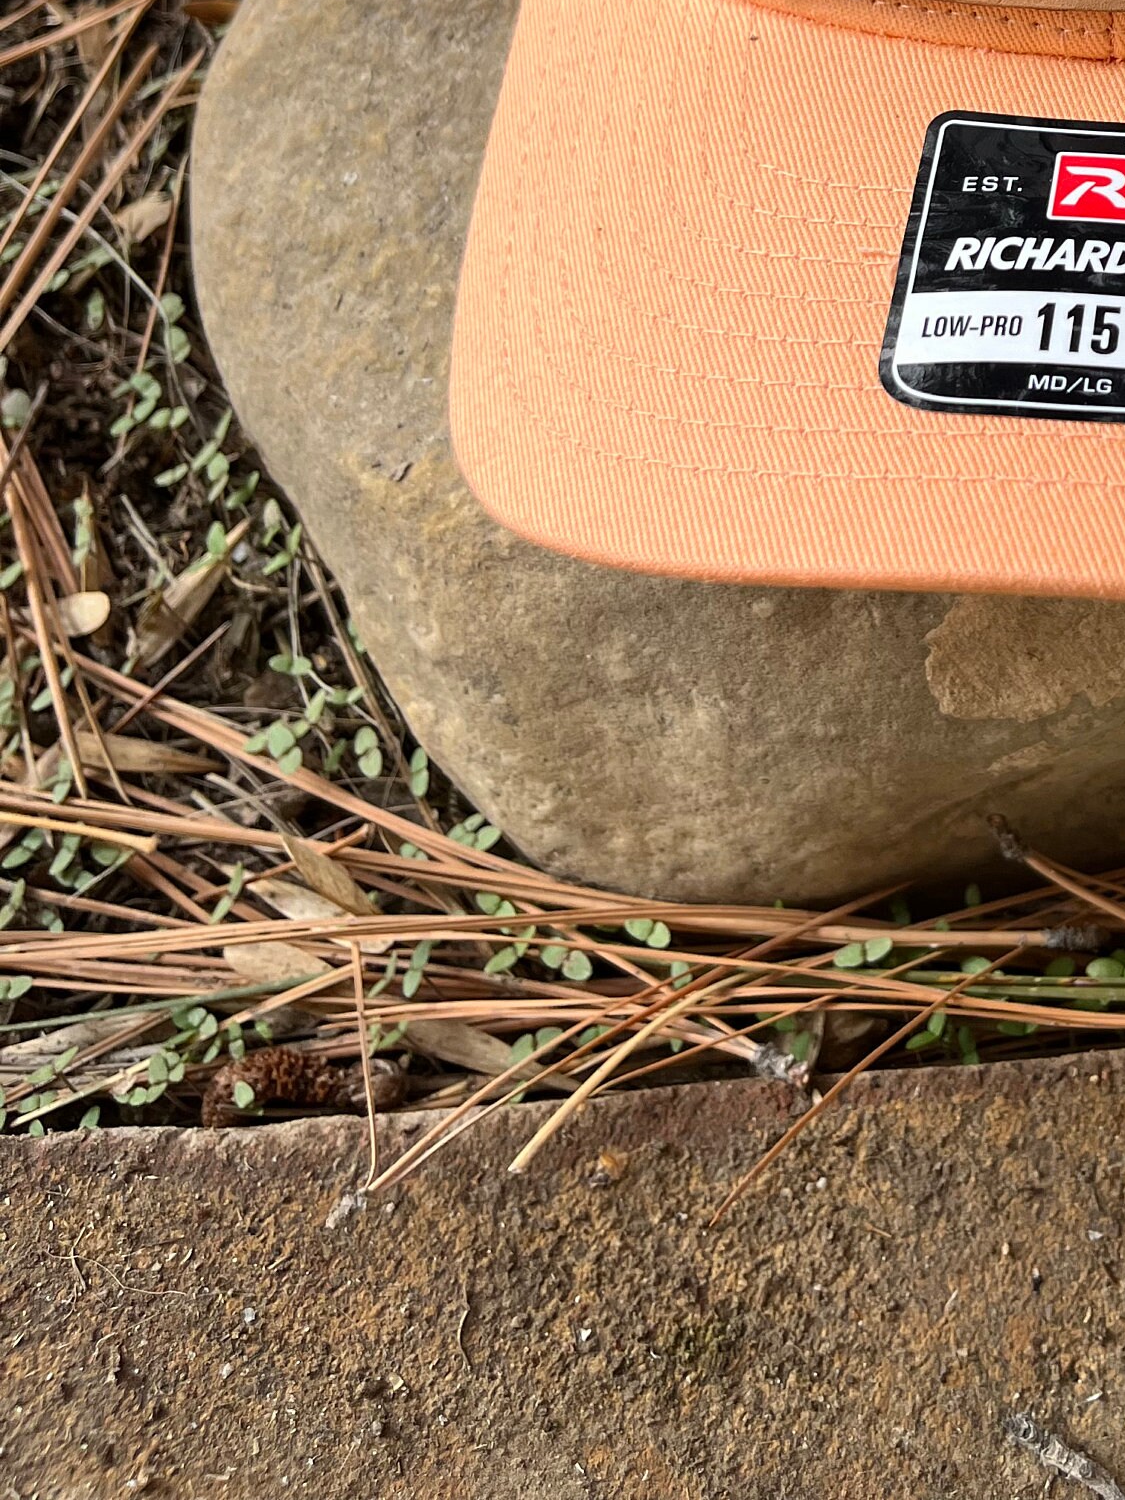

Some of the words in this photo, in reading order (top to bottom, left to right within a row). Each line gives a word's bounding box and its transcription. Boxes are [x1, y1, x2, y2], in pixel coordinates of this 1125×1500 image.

[961, 175, 1024, 193] EST.
[921, 315, 1024, 338] LOW-PRO
[1037, 302, 1122, 355] 115
[1027, 374, 1113, 394] MD/LG
